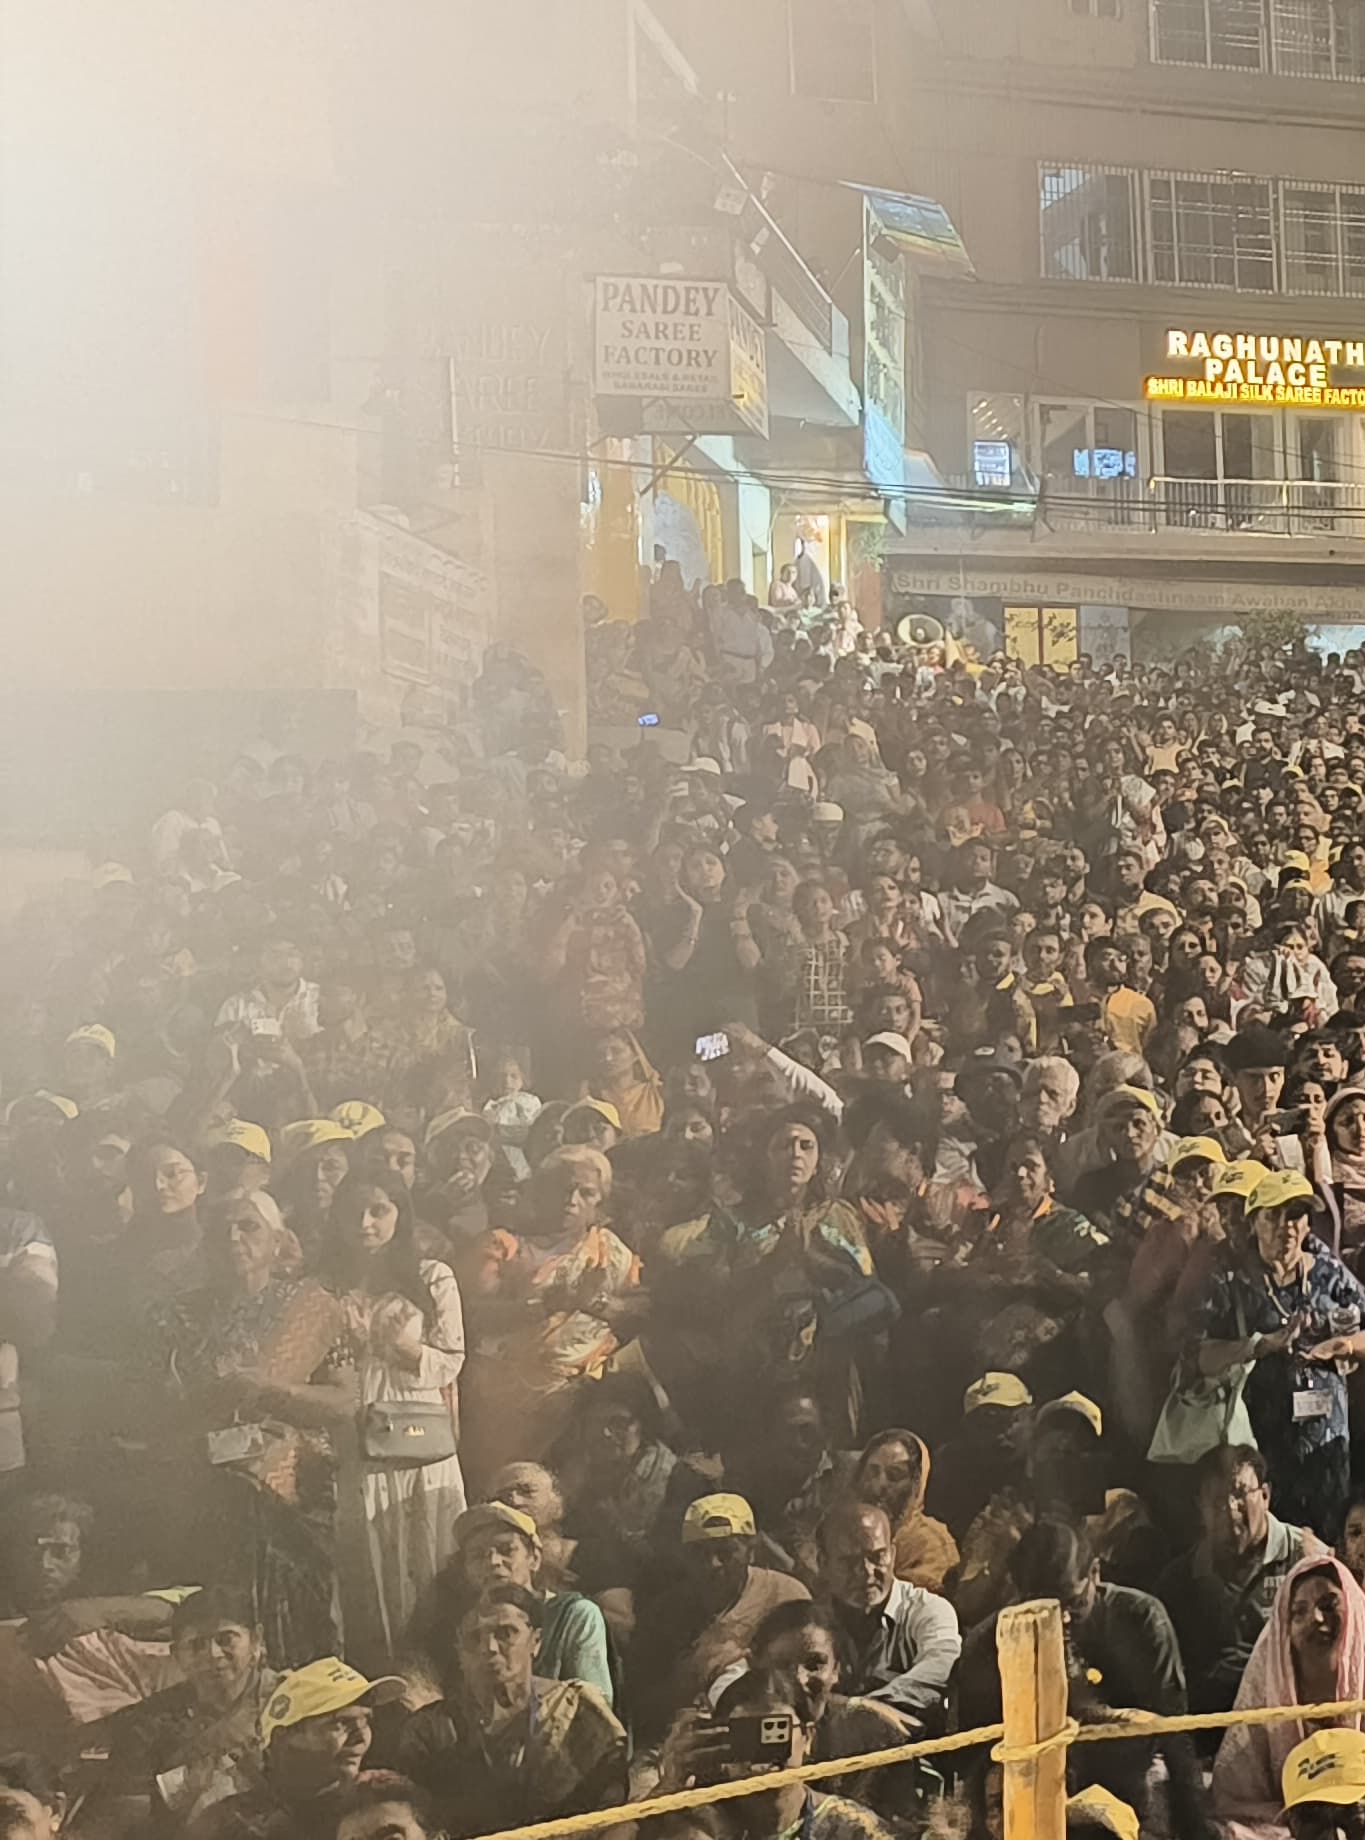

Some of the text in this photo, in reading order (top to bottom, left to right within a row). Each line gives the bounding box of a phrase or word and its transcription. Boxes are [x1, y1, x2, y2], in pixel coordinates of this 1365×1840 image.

[601, 282, 721, 317] PANDEY
[620, 319, 703, 342] SAREE
[603, 345, 719, 368] FACTORY
[1166, 330, 1365, 367] RAGHUNATH
[1204, 358, 1328, 388] PALACE
[1147, 376, 1184, 397] SHRI
[1186, 379, 1238, 400] BALAJI
[1240, 384, 1274, 401] SILK
[1275, 386, 1322, 404] SAREE
[898, 573, 941, 592] Shri
[949, 576, 1050, 597] Shambhu
